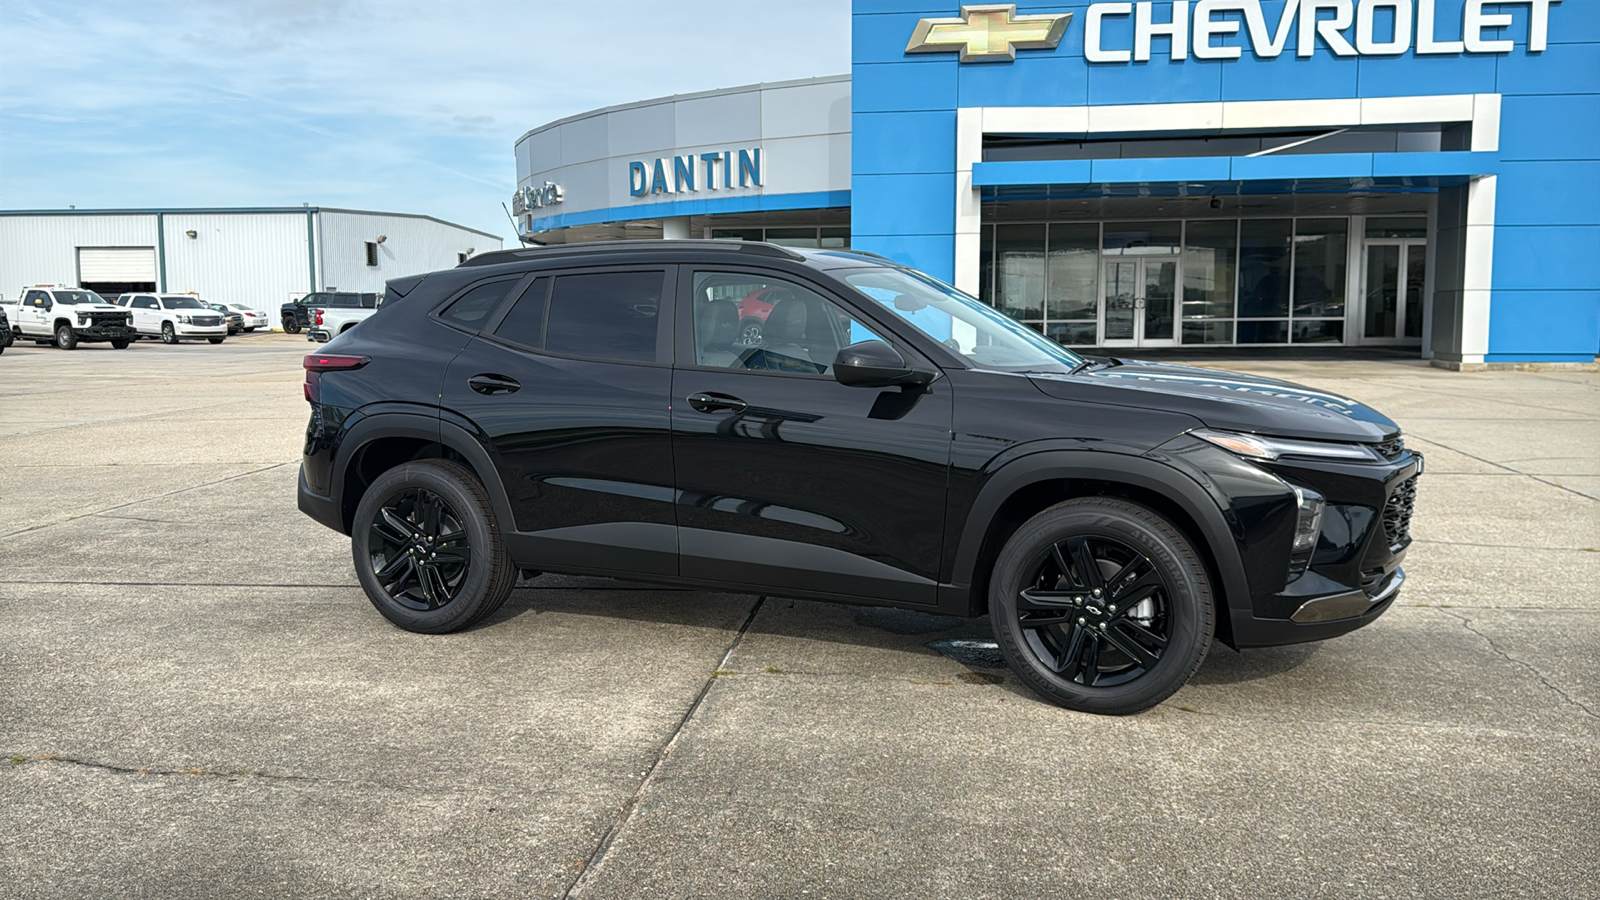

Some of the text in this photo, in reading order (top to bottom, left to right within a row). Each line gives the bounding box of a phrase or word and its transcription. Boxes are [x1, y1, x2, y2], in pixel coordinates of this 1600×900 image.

[1085, 0, 1561, 62] CHEVROLET
[629, 147, 764, 197] DANTIN
[1131, 530, 1189, 596] ASSURANCE
